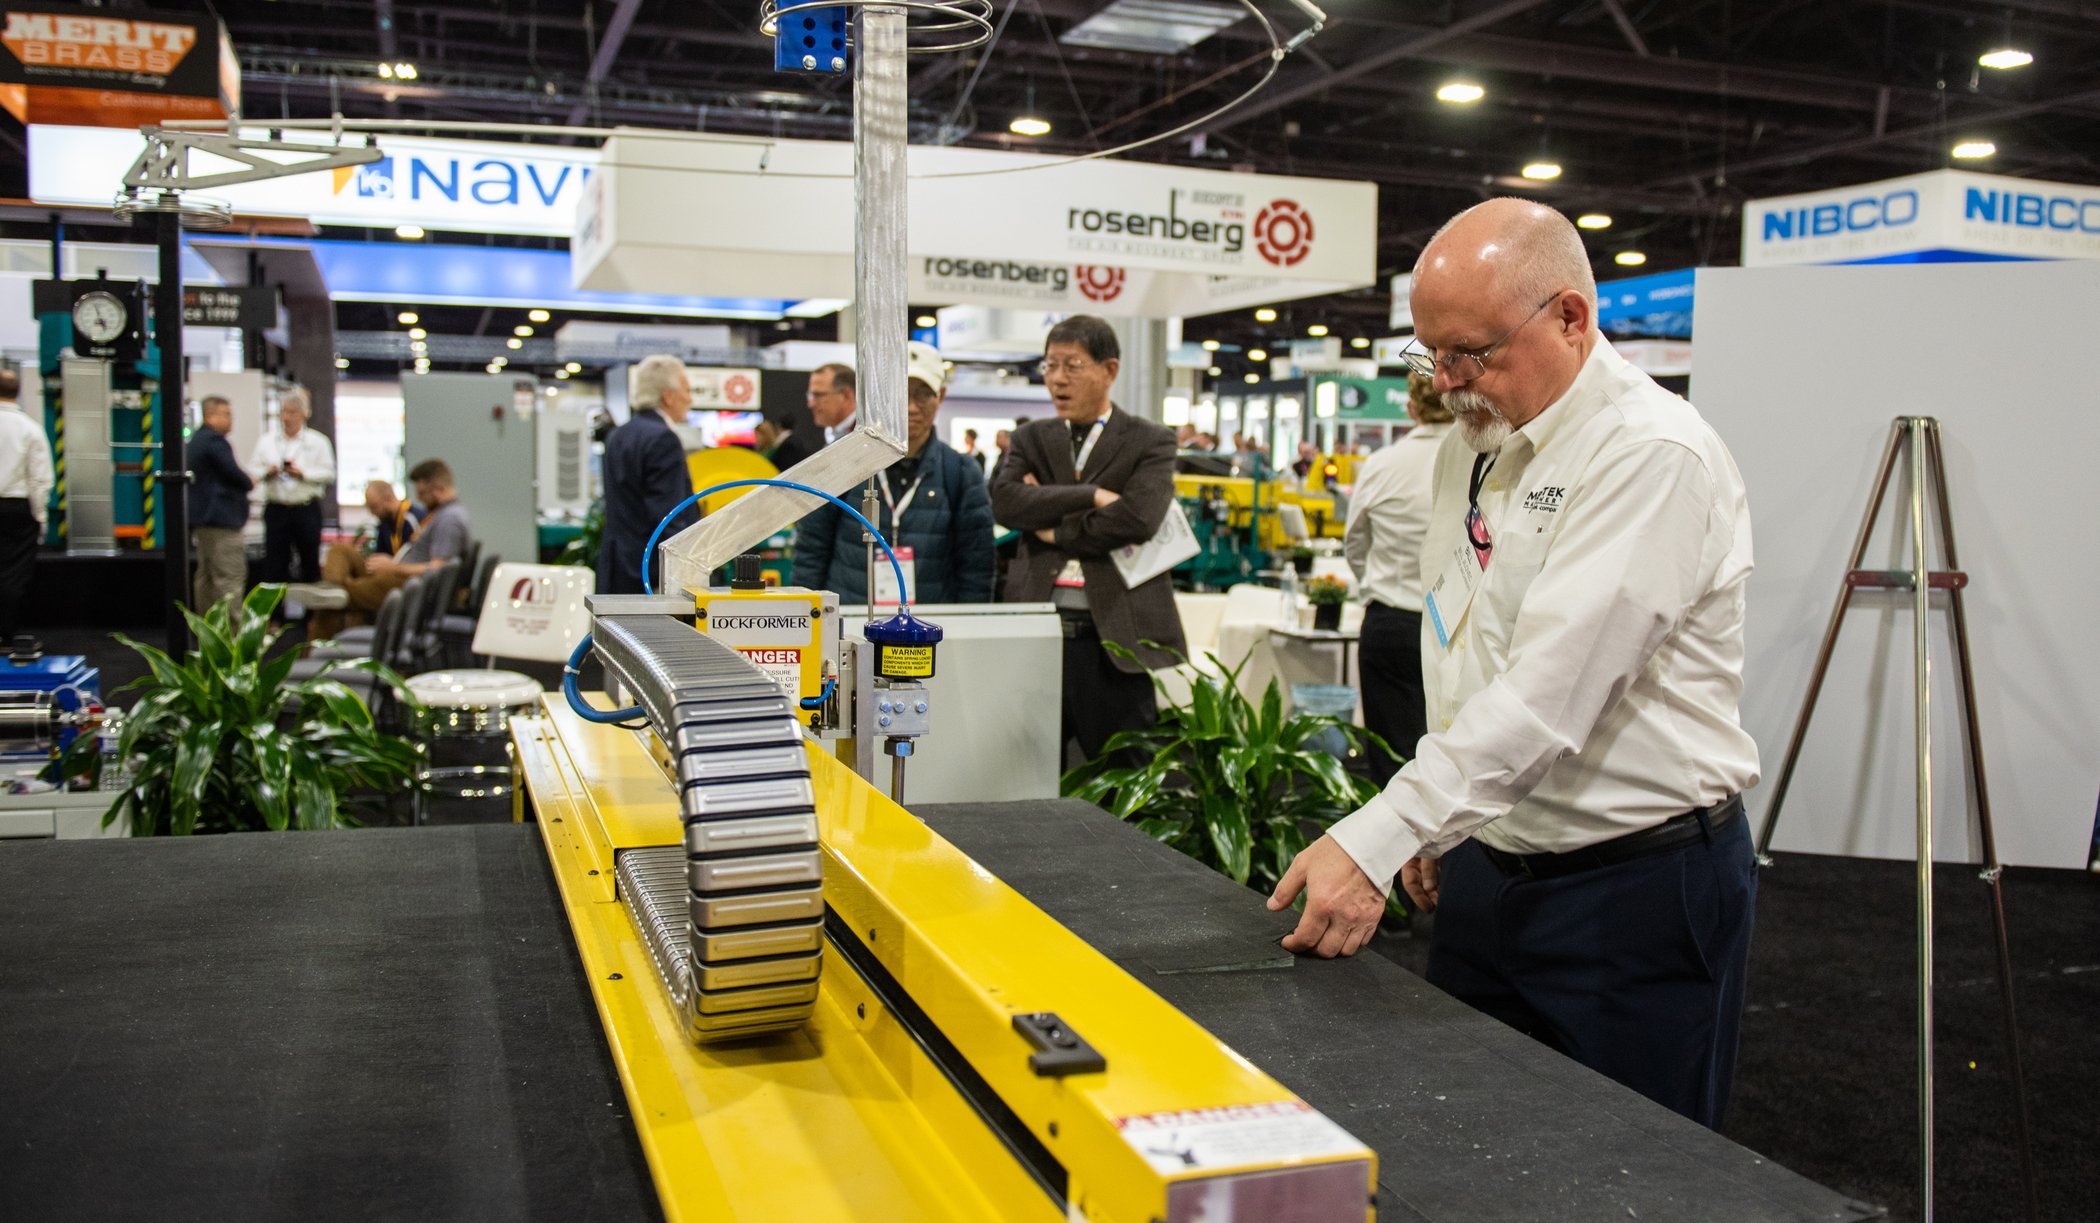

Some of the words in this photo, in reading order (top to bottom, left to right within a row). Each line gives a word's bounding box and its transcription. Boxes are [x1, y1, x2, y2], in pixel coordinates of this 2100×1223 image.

[2, 13, 194, 53] MERIT
[23, 41, 170, 74] BRASS
[1068, 187, 1245, 253] rosenberg
[1763, 190, 1919, 241] NIBCO
[1965, 186, 2100, 234] NIBCO
[924, 256, 1068, 291] rosenberg
[712, 615, 809, 629] LOCKFORMER
[741, 650, 798, 663] ANGER
[891, 648, 927, 656] WARNING
